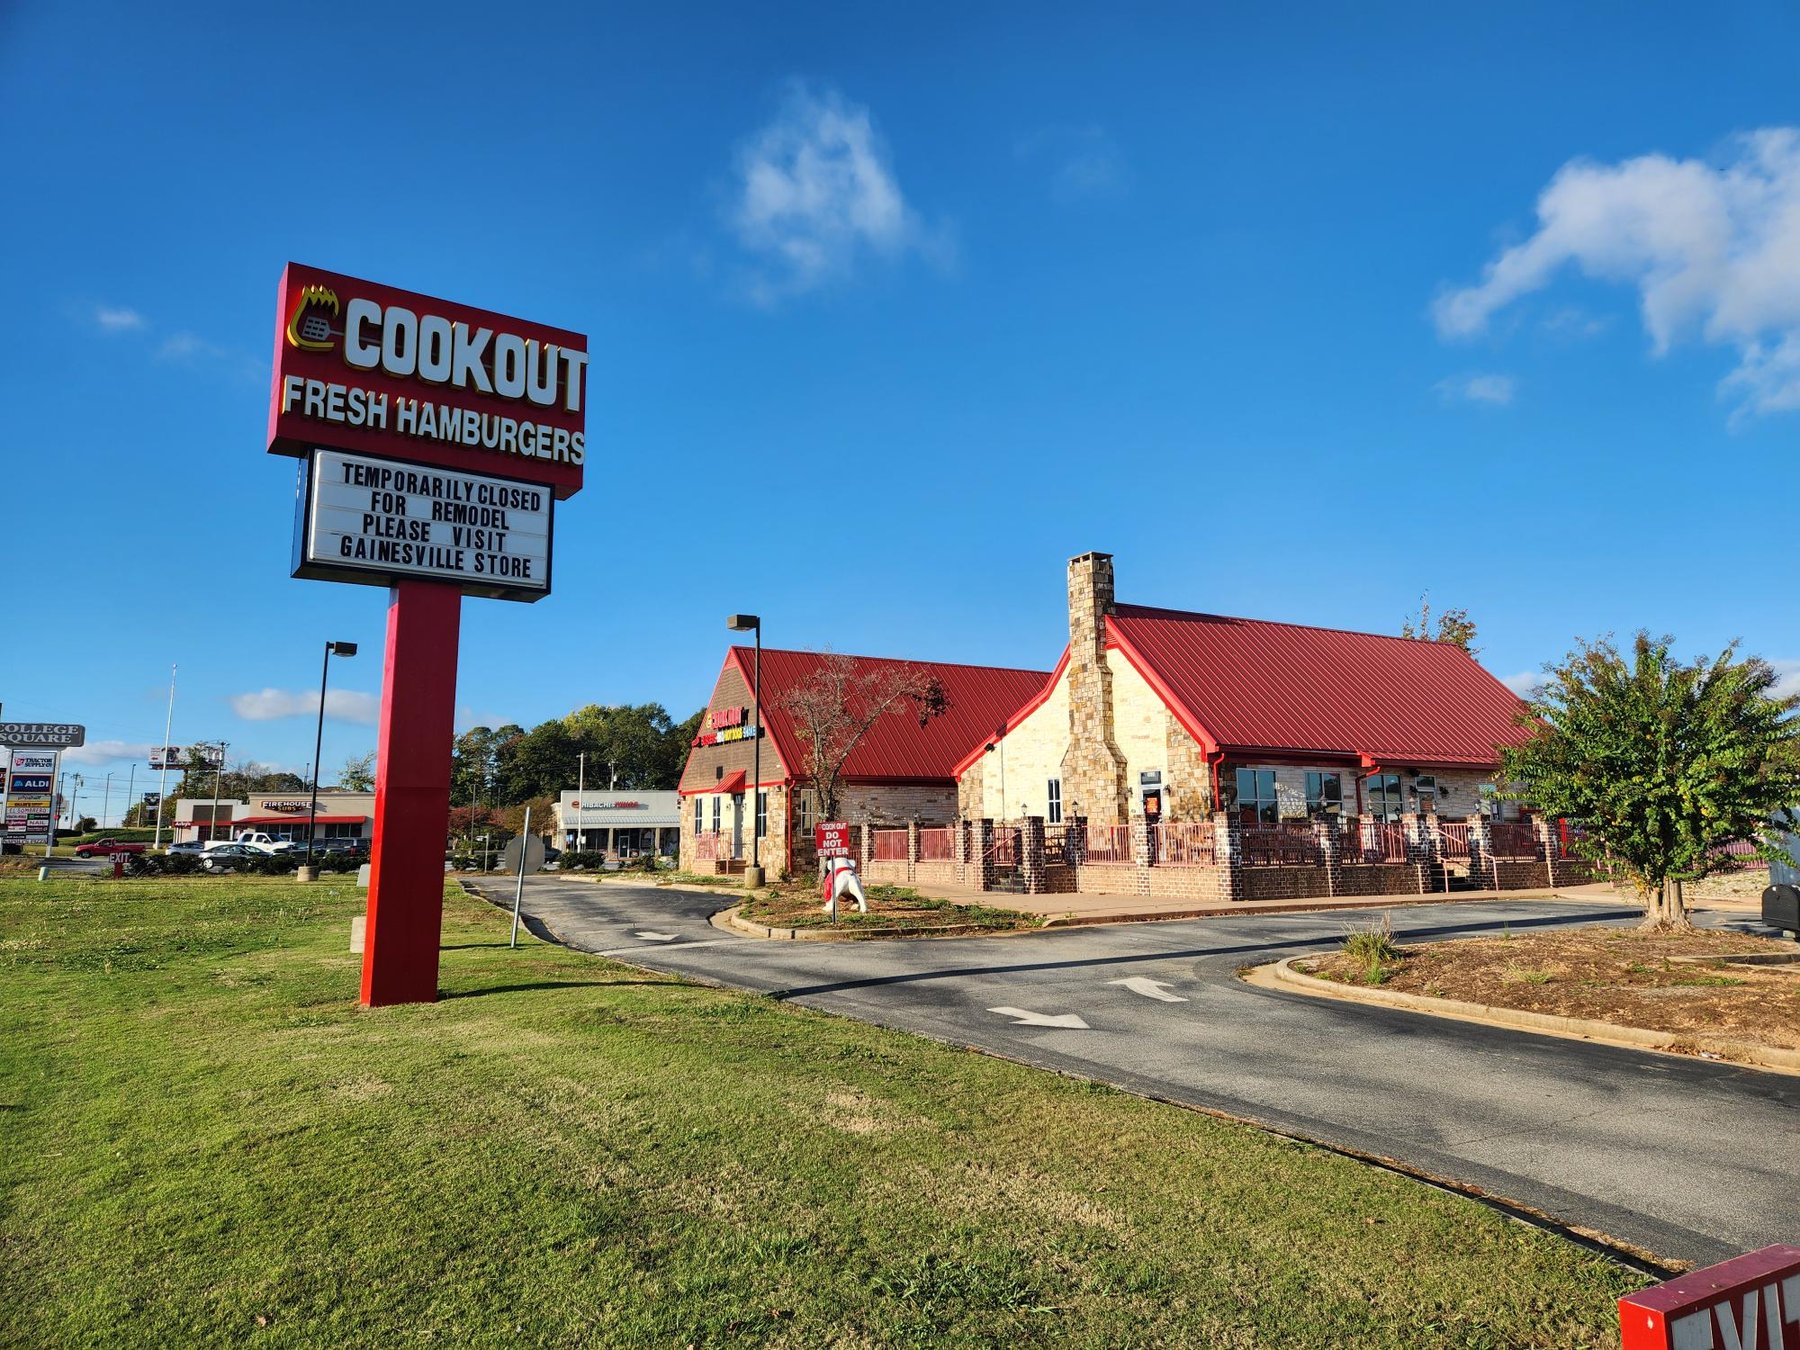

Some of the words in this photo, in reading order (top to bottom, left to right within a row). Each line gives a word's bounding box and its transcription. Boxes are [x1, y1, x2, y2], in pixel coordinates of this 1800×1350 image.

[283, 375, 388, 429] FRESH
[397, 397, 586, 465] HAMBURGERS
[342, 463, 473, 496] TEMPORARILY
[477, 484, 541, 512] CLOSED
[371, 491, 406, 516] FOR
[431, 502, 509, 531] REMODEL
[362, 513, 430, 542] PLEASE
[452, 526, 506, 552] VISIT
[340, 535, 464, 571] GAINESVILLE
[473, 552, 531, 579] STORE
[25, 780, 49, 788] ALDI
[263, 801, 312, 809] FIREHOUSE
[825, 831, 839, 840] DO
[823, 839, 843, 848] NOT
[109, 852, 130, 863] EXIT
[817, 847, 849, 857] ENTER
